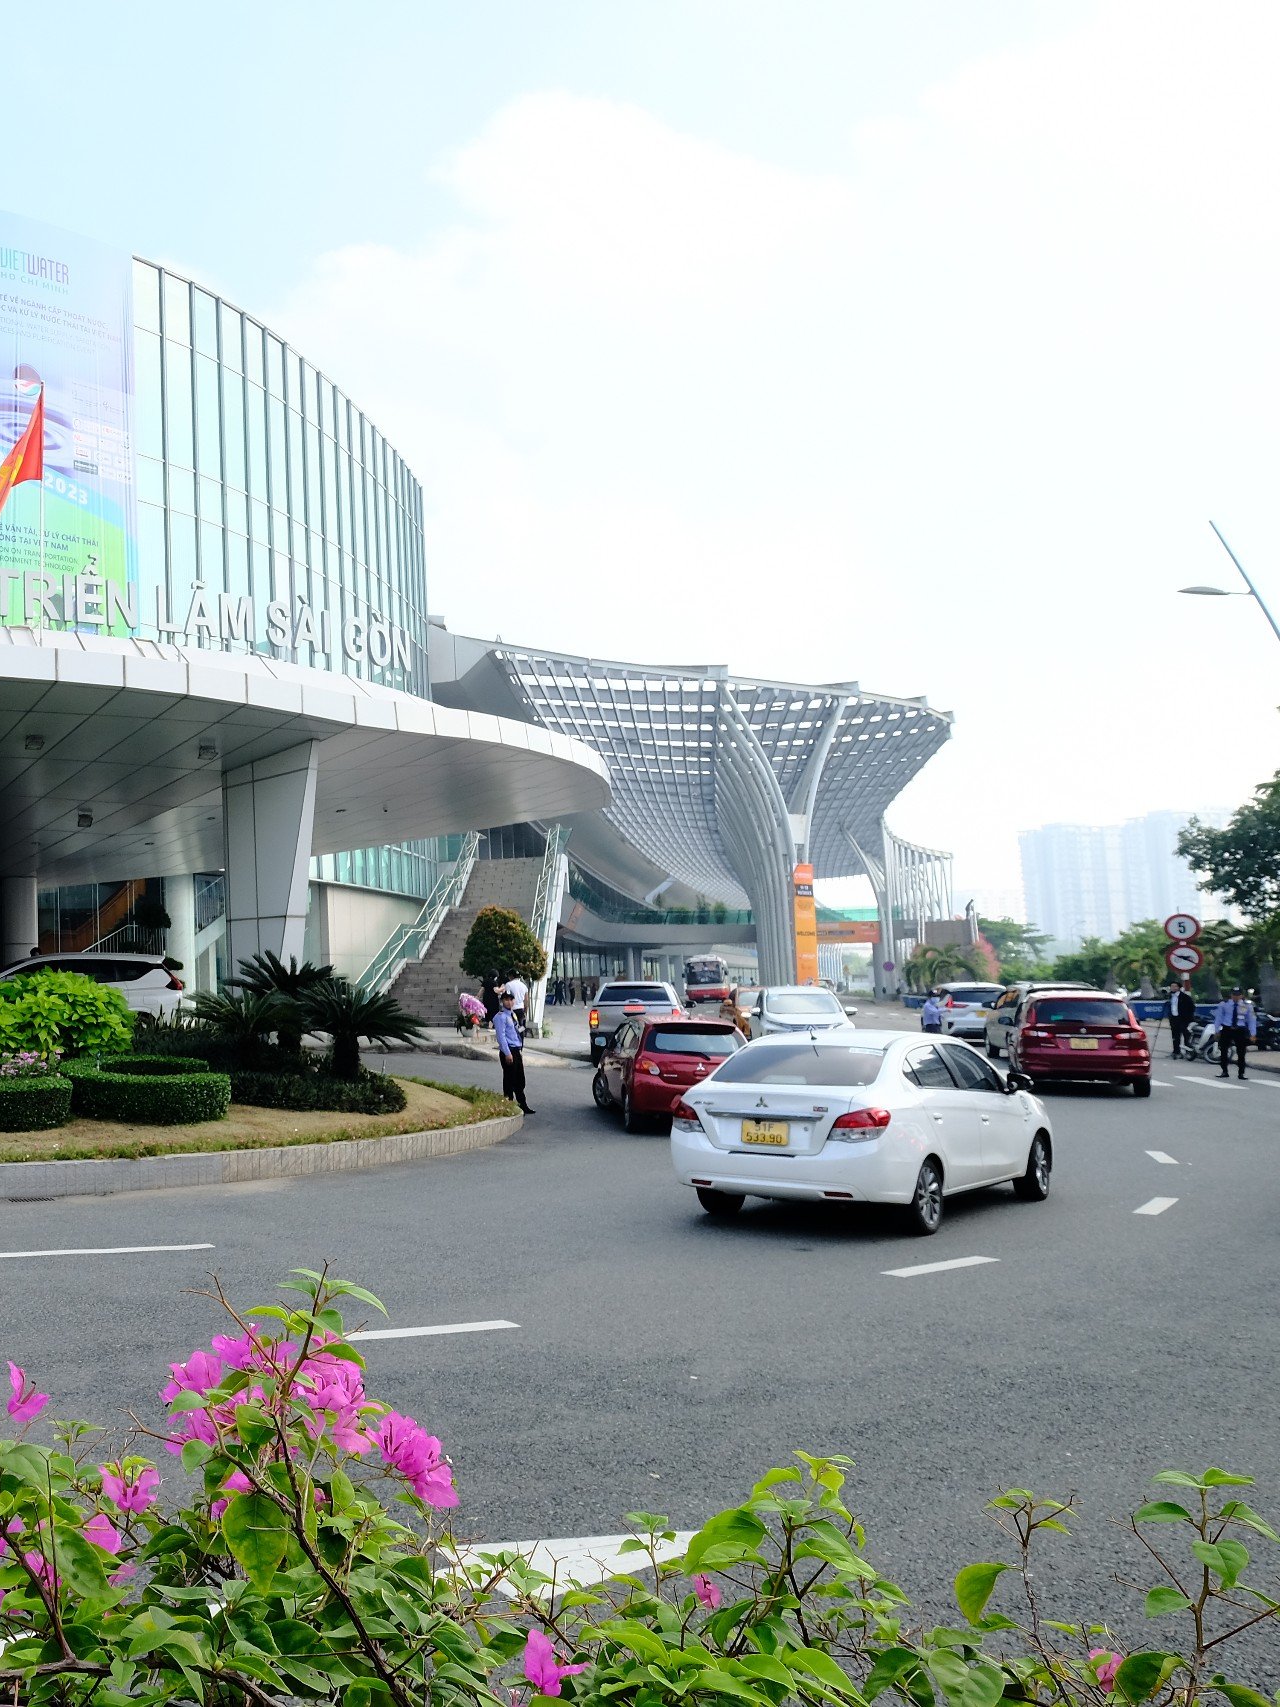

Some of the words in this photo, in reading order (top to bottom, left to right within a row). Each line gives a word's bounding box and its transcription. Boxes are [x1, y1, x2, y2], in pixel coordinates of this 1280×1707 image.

[11, 547, 21, 555] ON
[51, 542, 69, 551] NAM
[156, 580, 254, 643] LÃM
[266, 594, 331, 654] SÀI
[342, 611, 412, 672] GÒN
[1178, 921, 1186, 934] 5
[746, 1131, 783, 1144] 533.90
